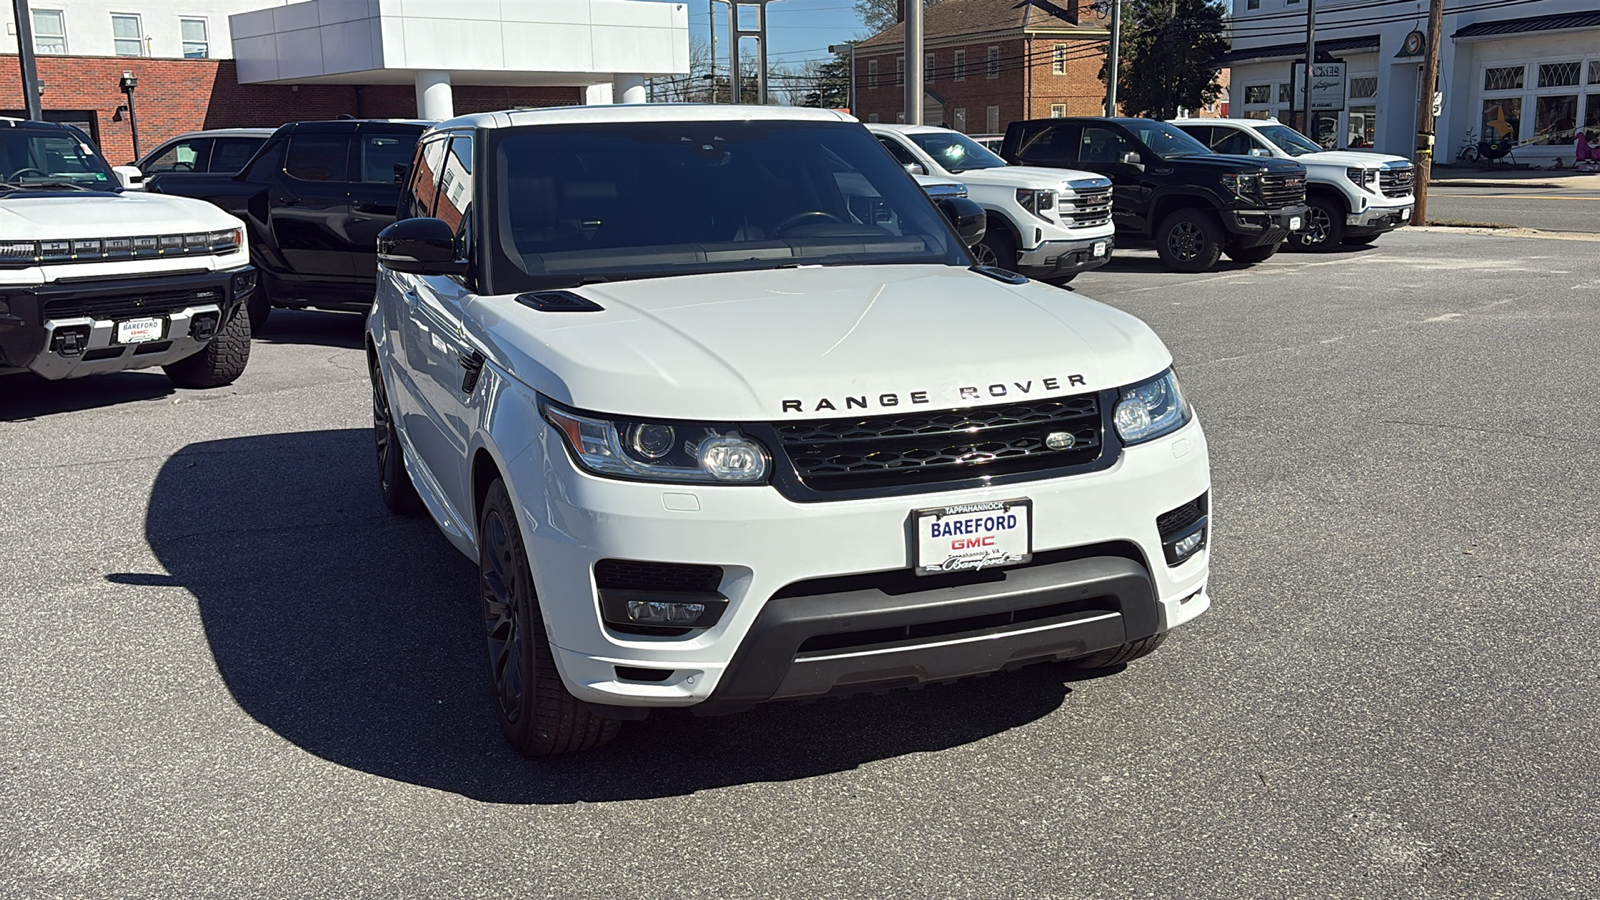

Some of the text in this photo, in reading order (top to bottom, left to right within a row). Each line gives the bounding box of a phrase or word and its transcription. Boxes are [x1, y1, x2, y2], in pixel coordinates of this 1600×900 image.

[123, 321, 158, 331] BAREFORD
[782, 374, 1087, 413] RANGE ROVER
[945, 502, 1004, 515] TAPPAHANNOCK
[931, 515, 1017, 538] BAREFORD
[951, 535, 995, 550] GMC
[942, 552, 1007, 571] Bareford
